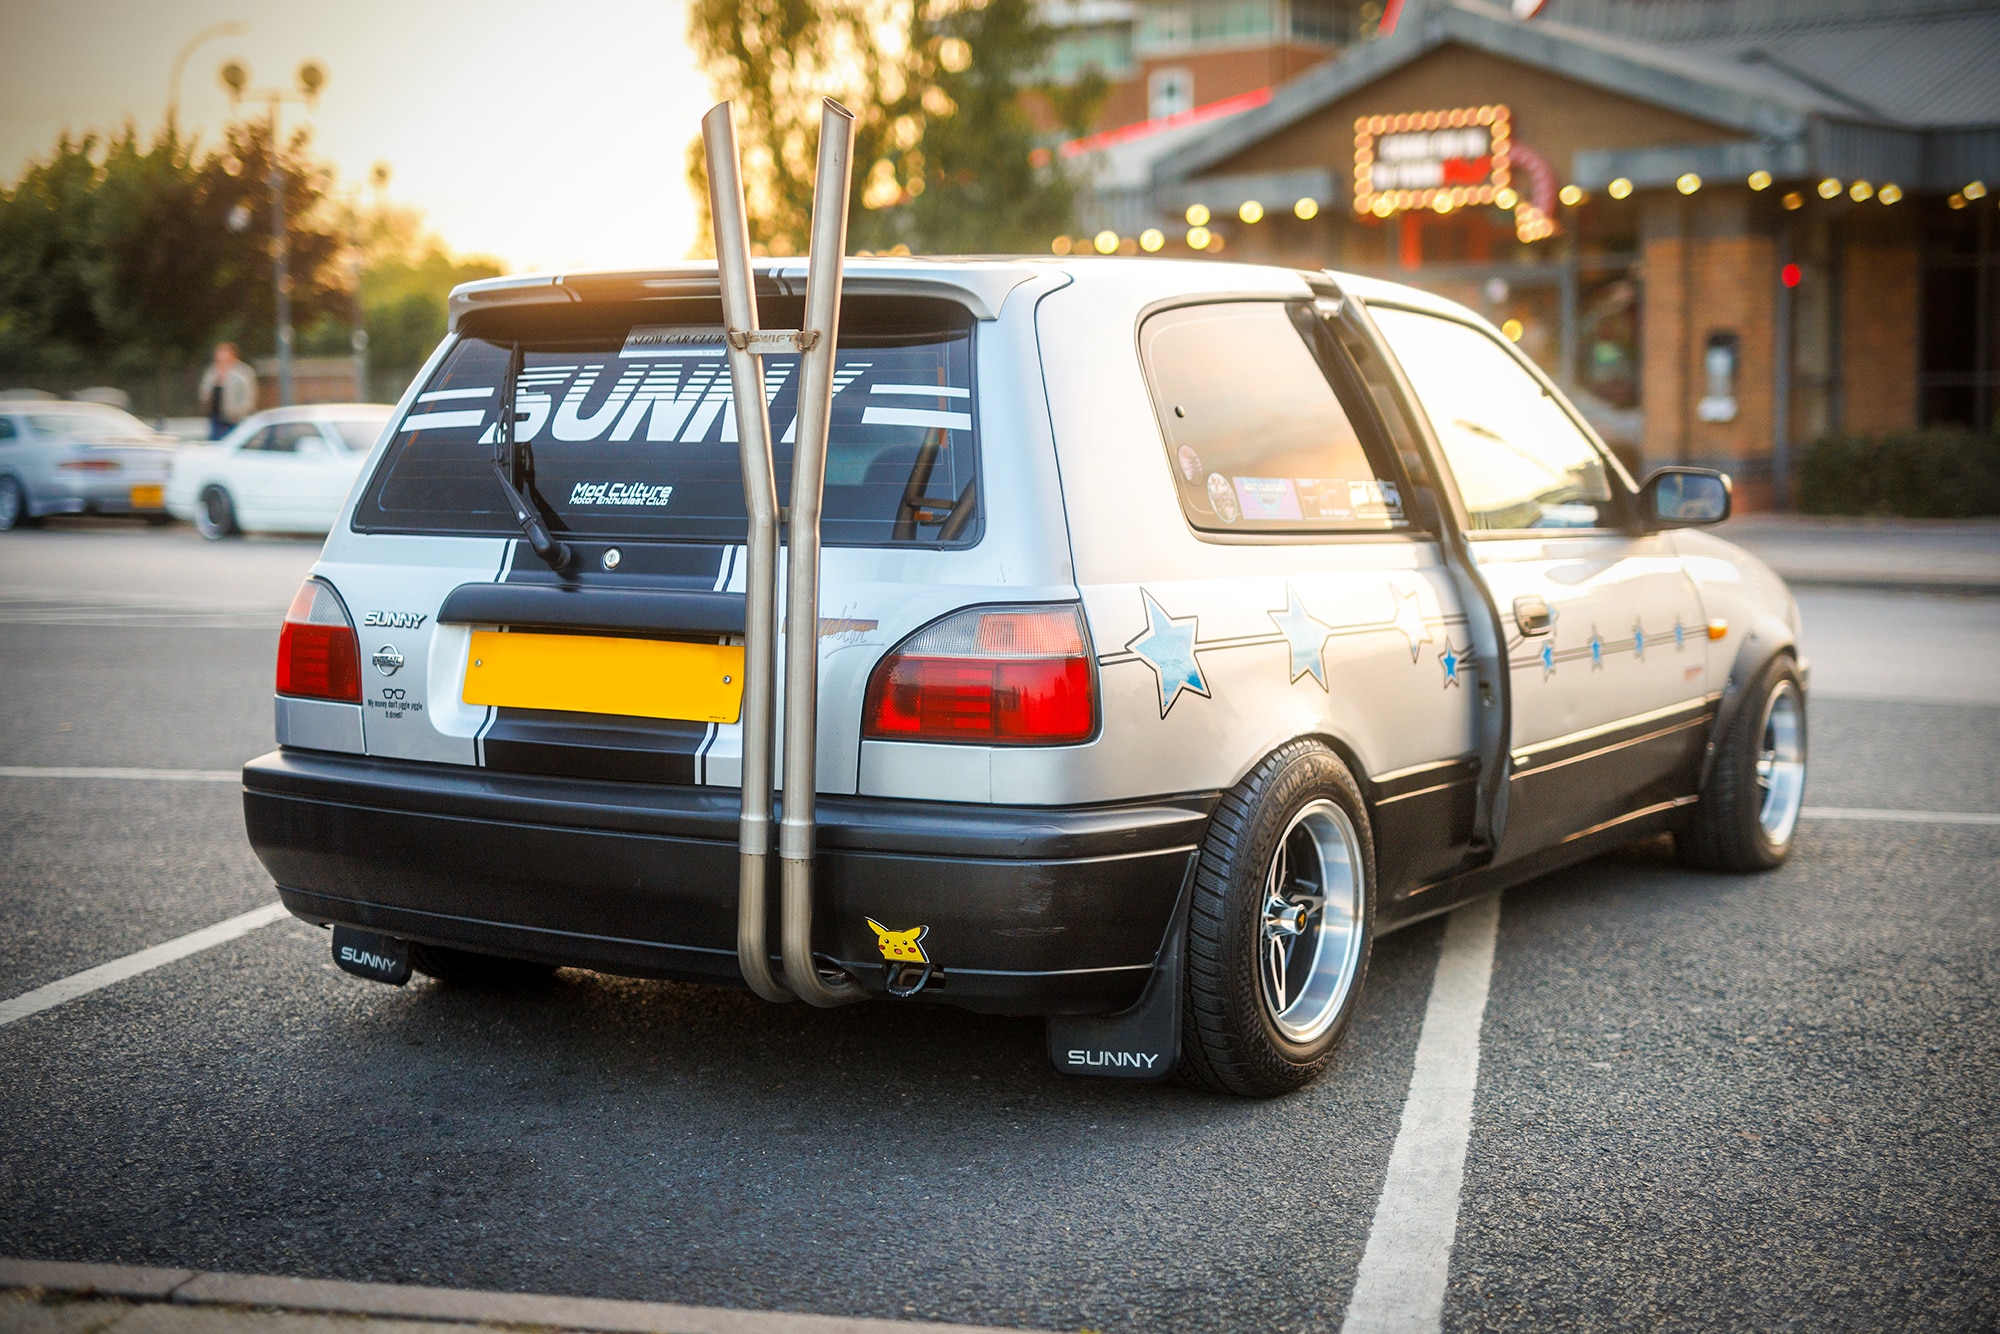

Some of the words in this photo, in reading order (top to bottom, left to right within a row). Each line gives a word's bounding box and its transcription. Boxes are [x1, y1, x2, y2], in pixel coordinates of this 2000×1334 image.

[631, 334, 665, 346] SLOW
[665, 334, 691, 345] CAR
[691, 333, 726, 345] CLUB
[749, 334, 798, 344] SWIFT
[608, 482, 673, 498] Culture
[569, 496, 596, 504] Motor
[596, 496, 646, 505] Enthusiast
[645, 497, 669, 506] Club
[364, 610, 428, 629] SUNNY
[367, 698, 374, 709] My
[374, 700, 388, 710] money
[388, 700, 398, 708] don't
[341, 946, 396, 973] SUNNY
[1068, 1049, 1159, 1069] SUNNY
